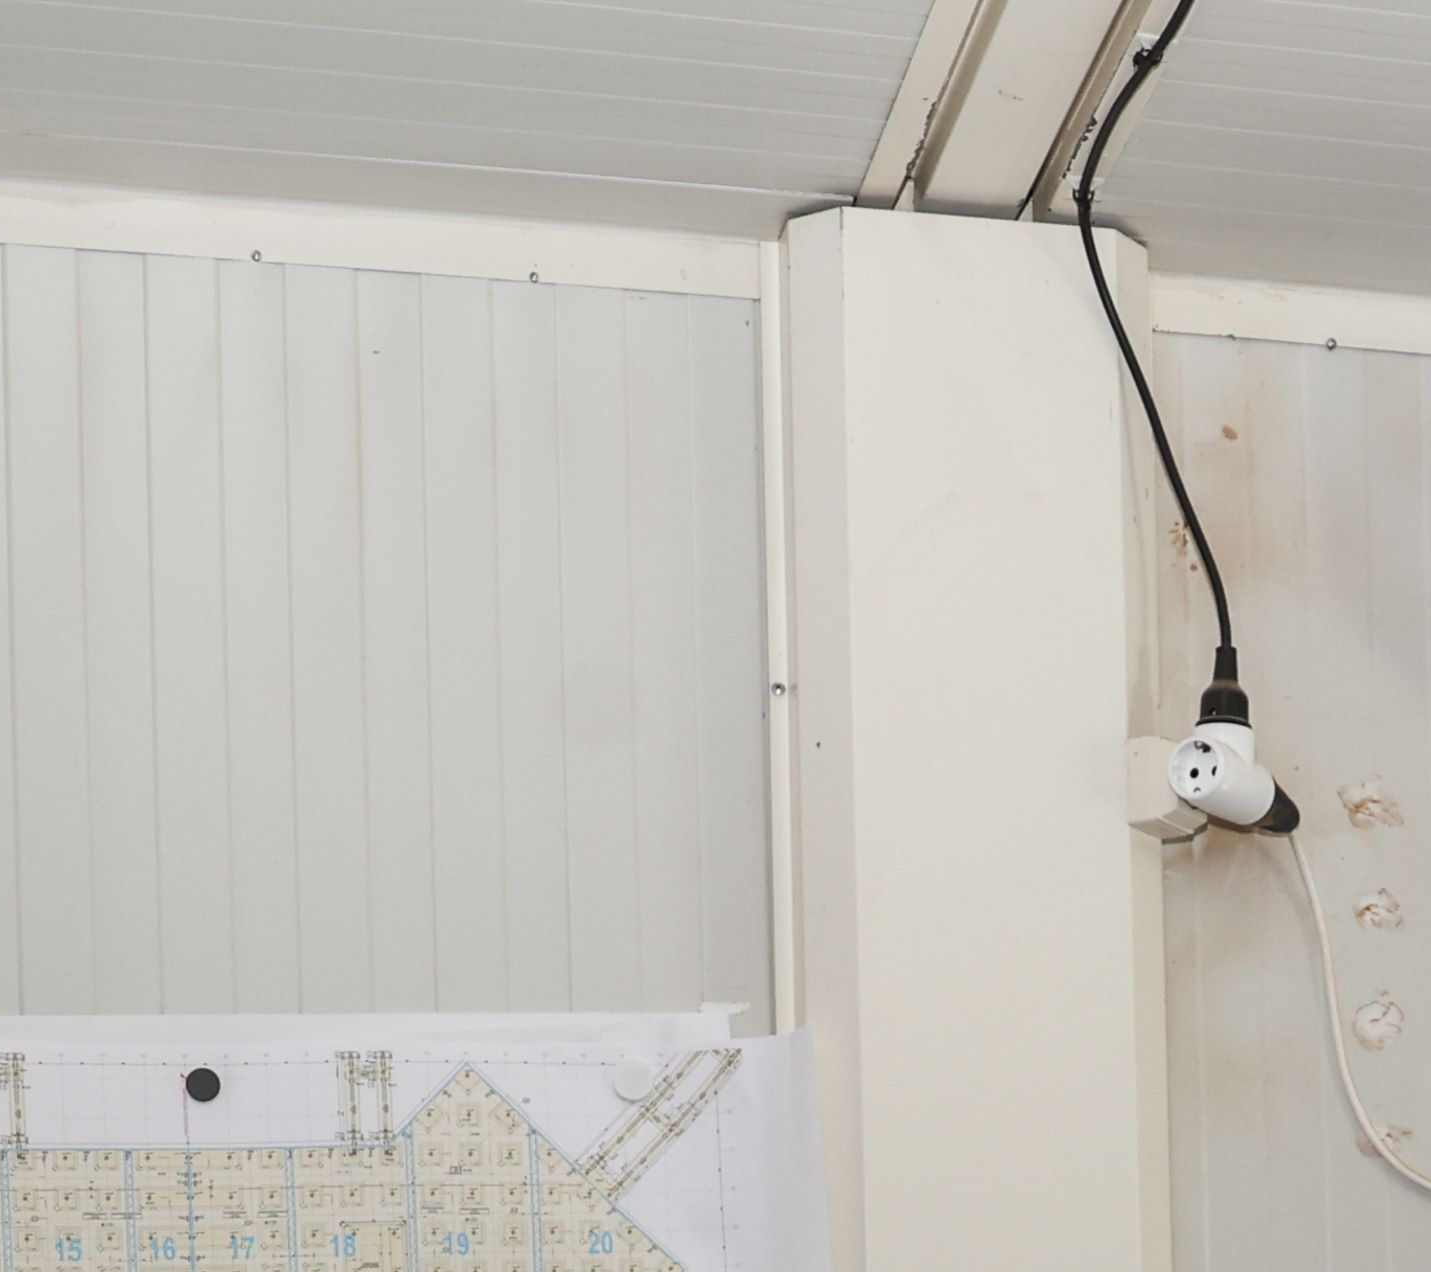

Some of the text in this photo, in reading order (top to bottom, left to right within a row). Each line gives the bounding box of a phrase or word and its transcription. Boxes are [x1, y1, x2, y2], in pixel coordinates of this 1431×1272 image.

[56, 1238, 82, 1262] 15
[150, 1237, 176, 1260] 16
[229, 1237, 255, 1260] 17
[330, 1234, 356, 1257] 18
[443, 1234, 470, 1256] 19
[589, 1232, 613, 1254] 20
